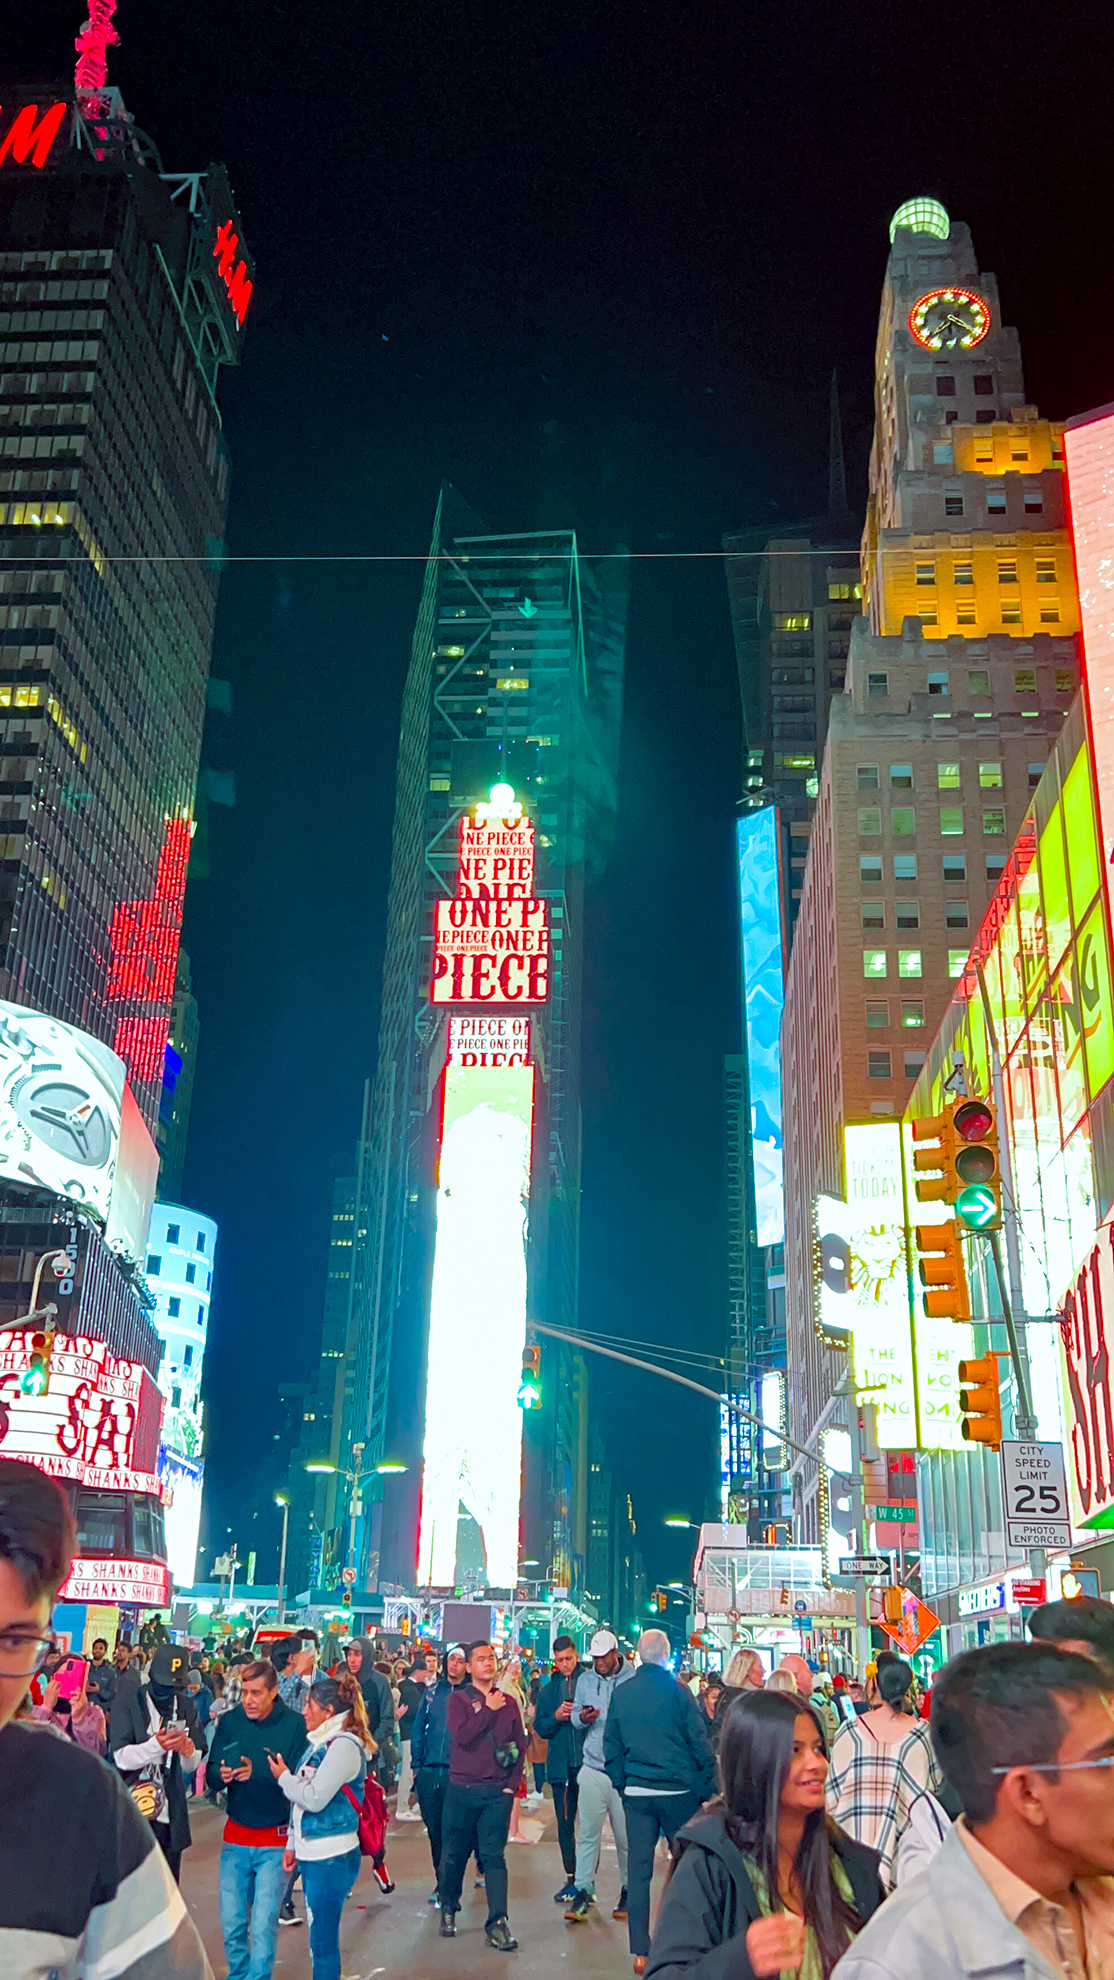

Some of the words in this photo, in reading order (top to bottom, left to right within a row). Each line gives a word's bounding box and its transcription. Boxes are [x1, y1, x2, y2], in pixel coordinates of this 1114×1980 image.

[487, 832, 525, 845] PIECE
[468, 848, 491, 856] PIECE
[494, 848, 511, 856] ONE
[448, 900, 512, 928] ONE
[452, 930, 489, 943] PIECE
[491, 930, 534, 951] ONE
[460, 1019, 506, 1036] PIECE
[457, 1039, 487, 1049] PIECE
[490, 1039, 510, 1049] ONE
[853, 1177, 897, 1198] TODAY
[869, 1348, 895, 1360] THE
[1020, 1446, 1044, 1455] CITY
[1015, 1458, 1051, 1468] SPEED
[88, 1469, 140, 1489] SHANKS
[1020, 1471, 1048, 1480] LIMIT
[1014, 1485, 1060, 1514] 25
[878, 1507, 887, 1519] W
[892, 1508, 904, 1520] 45
[1023, 1526, 1055, 1535] PHOTO
[1014, 1535, 1066, 1545] ENFORCED
[92, 1562, 139, 1579] SHANKS
[847, 1562, 861, 1570] ONE
[869, 1562, 884, 1570] WAY
[74, 1582, 126, 1599] SHANKS
[170, 1658, 181, 1673] P
